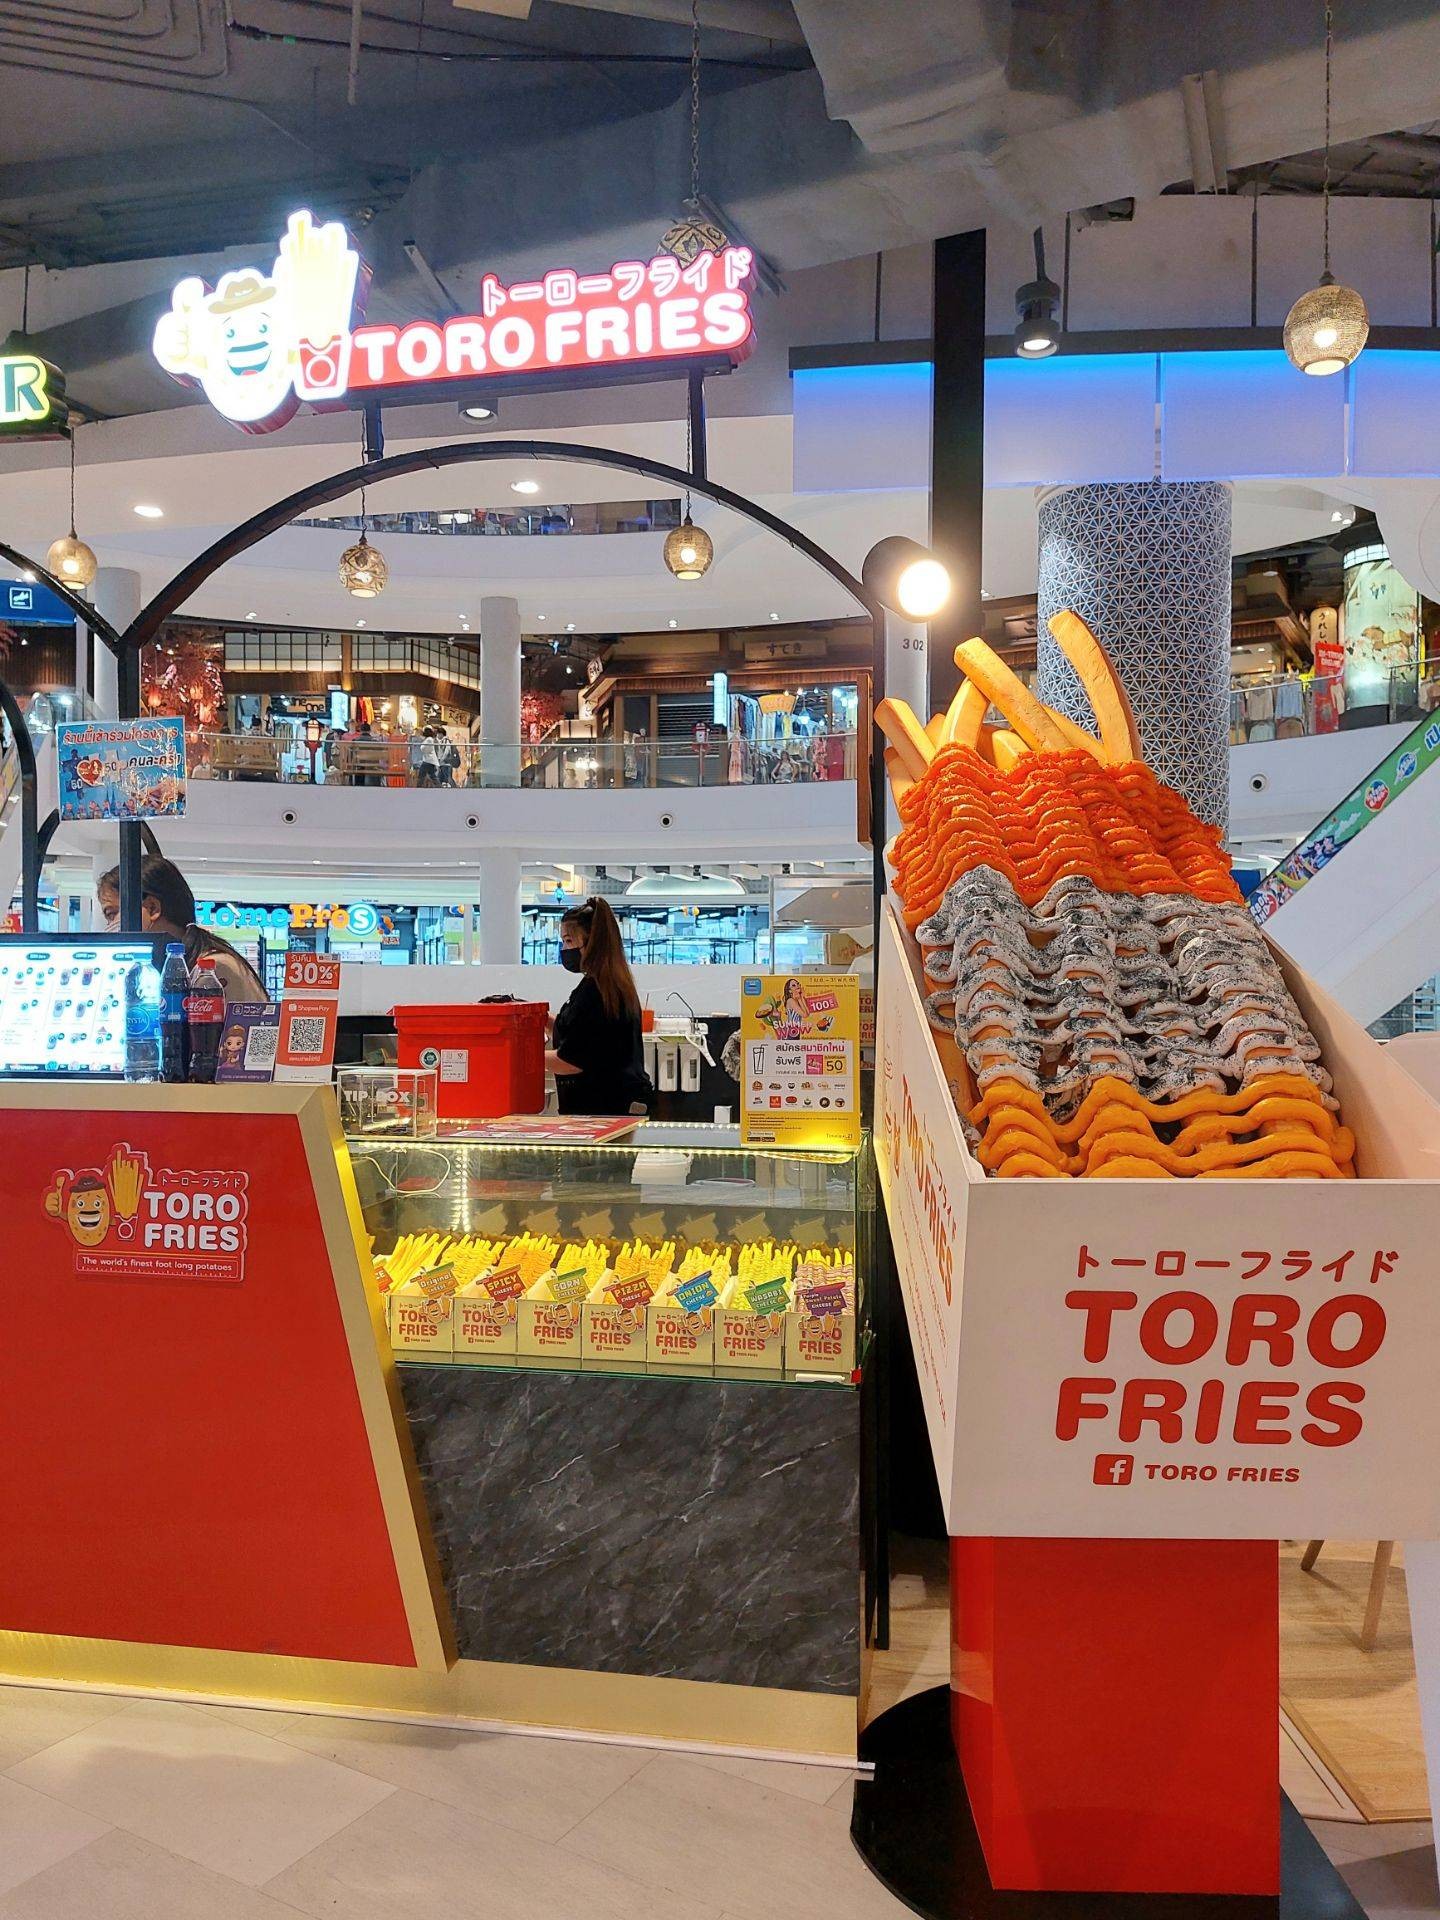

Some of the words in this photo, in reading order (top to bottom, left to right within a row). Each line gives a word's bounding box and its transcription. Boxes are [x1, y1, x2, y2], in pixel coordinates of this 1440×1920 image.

[482, 247, 753, 318] トーローフライド
[354, 316, 536, 382] TORO
[544, 292, 748, 364] FRIES
[288, 962, 334, 985] 30%
[810, 1000, 830, 1012] 100
[773, 1019, 814, 1029] SUMMER
[775, 1026, 813, 1040] WOW
[775, 1041, 845, 1052] สมัครสมาชิกใหม่
[775, 1056, 802, 1066] รับฟรี
[826, 1060, 843, 1072] 50
[343, 1090, 369, 1102] TIP
[375, 1091, 411, 1103] BOX
[160, 1175, 241, 1188] トーローフライド
[143, 1191, 241, 1222] TORO
[144, 1222, 240, 1252] FRIES
[82, 1256, 98, 1265] The
[100, 1257, 128, 1267] world's
[130, 1259, 153, 1268] finest
[155, 1259, 172, 1269] foot
[174, 1260, 193, 1271] long
[195, 1262, 233, 1273] potatoes
[1077, 1244, 1399, 1284] トーローフライド
[420, 1272, 452, 1288] Original
[486, 1274, 517, 1291] SPICY
[553, 1278, 580, 1292] CORN
[614, 1280, 648, 1298] PIZZA
[678, 1281, 709, 1300] ONION
[750, 1288, 783, 1304] WASABI
[621, 1292, 642, 1303] CHEESE
[685, 1294, 706, 1306] CHEESE
[398, 1323, 438, 1337] FRIES
[462, 1324, 502, 1338] FRIES
[533, 1325, 574, 1340] FRIES
[1064, 1290, 1388, 1369] TORO
[590, 1331, 632, 1345] FRIES
[655, 1335, 697, 1349] FRIES
[723, 1336, 766, 1351] FRIES
[798, 1340, 842, 1355] FRIES
[1055, 1376, 1367, 1448] FRIES
[1144, 1463, 1218, 1481] TORO
[1226, 1466, 1301, 1483] FRIES
